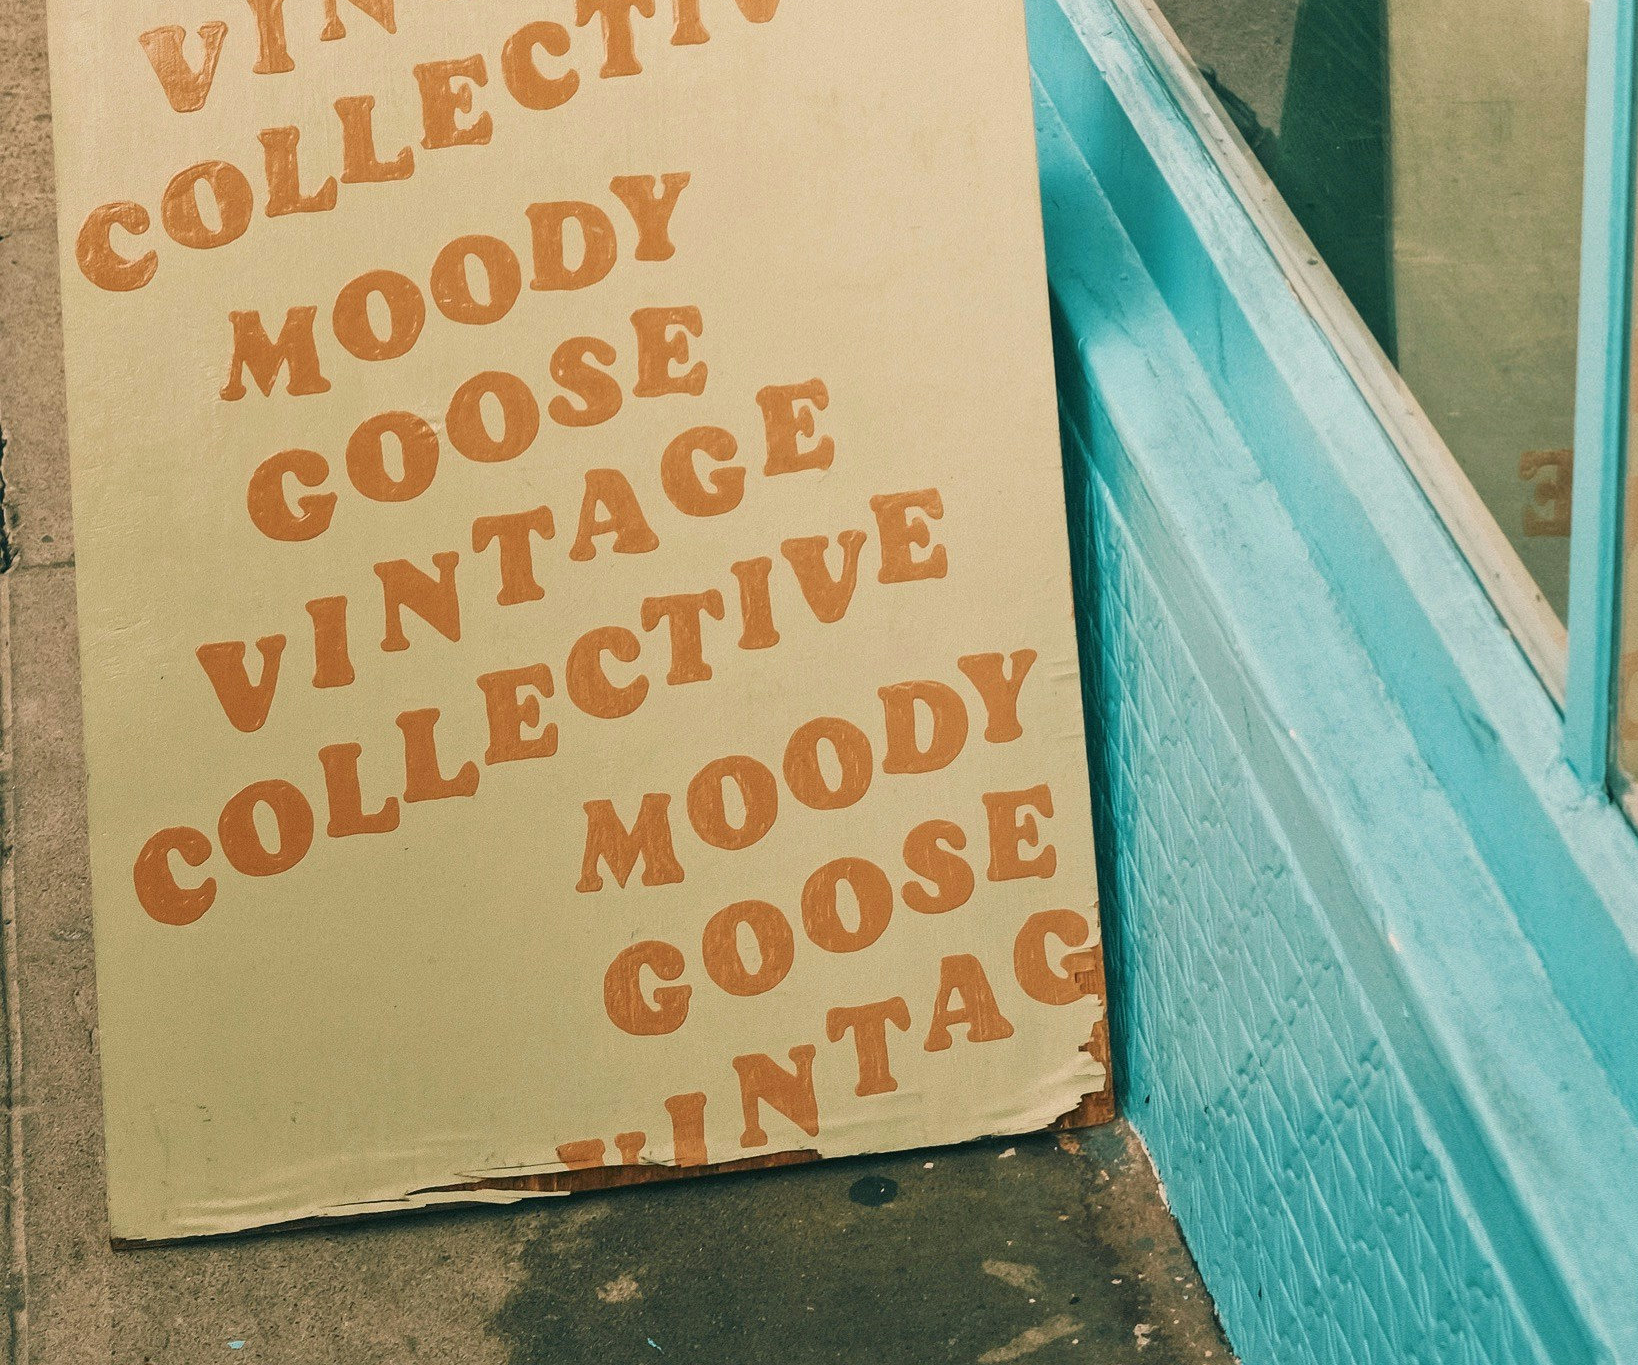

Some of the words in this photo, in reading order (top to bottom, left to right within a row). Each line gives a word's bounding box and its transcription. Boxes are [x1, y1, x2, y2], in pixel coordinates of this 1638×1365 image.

[220, 172, 690, 402] MOODY
[246, 305, 708, 543] GOOSE
[195, 378, 836, 733] VINTAGE
[132, 488, 949, 927] COLLECTIVE
[576, 649, 1038, 894] MOODY
[603, 784, 1057, 1038] GOOSE
